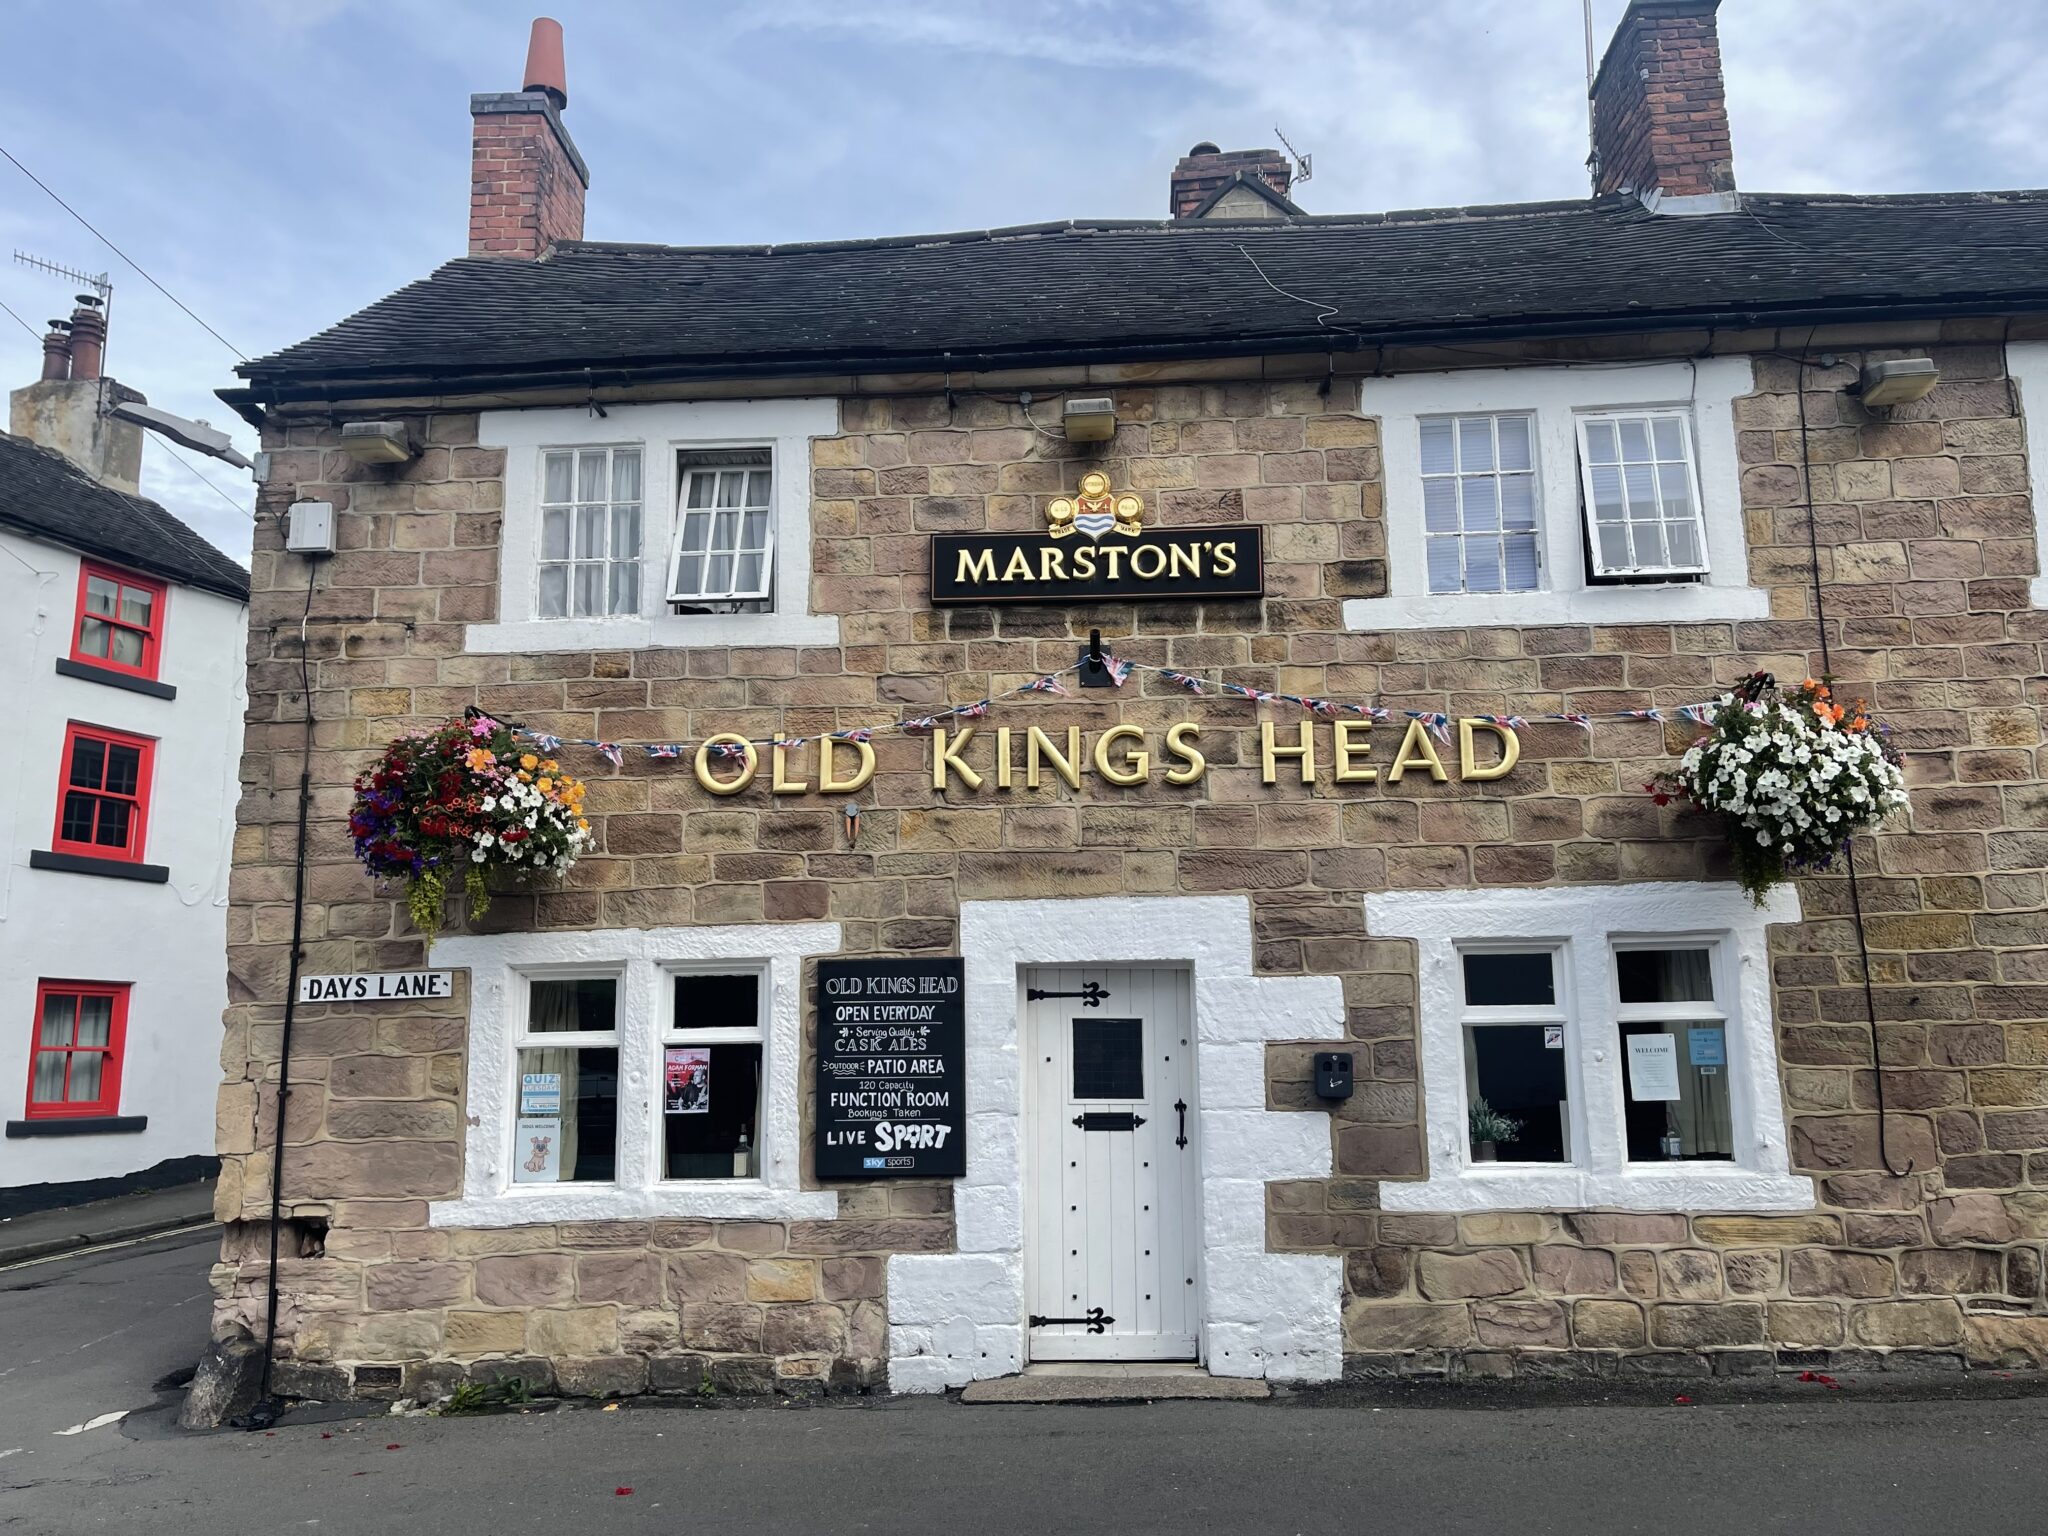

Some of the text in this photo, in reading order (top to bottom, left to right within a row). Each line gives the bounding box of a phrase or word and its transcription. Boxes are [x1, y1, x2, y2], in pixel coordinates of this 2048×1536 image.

[1055, 527, 1071, 535] TRADE
[954, 541, 1237, 585] MARSTON'S
[694, 717, 1521, 796] OLD KINGS HEAD
[308, 974, 441, 1000] DAYS LANE
[825, 976, 959, 995] OLD KINGS HEAD
[835, 1005, 936, 1021] OPEN EVERYDAY
[855, 1026, 915, 1040] Serving Quality
[834, 1038, 927, 1052] CASK ALES
[828, 1059, 945, 1074] OUTDOOR PATIO AREA
[524, 1074, 556, 1084] QUIZ
[859, 1080, 914, 1093] 120 Capacity
[830, 1091, 949, 1107] FUNCTION ROOM
[847, 1108, 921, 1120] Bookings Taken
[827, 1121, 952, 1152] LIVE SPORT
[865, 1157, 912, 1168] sky sports
